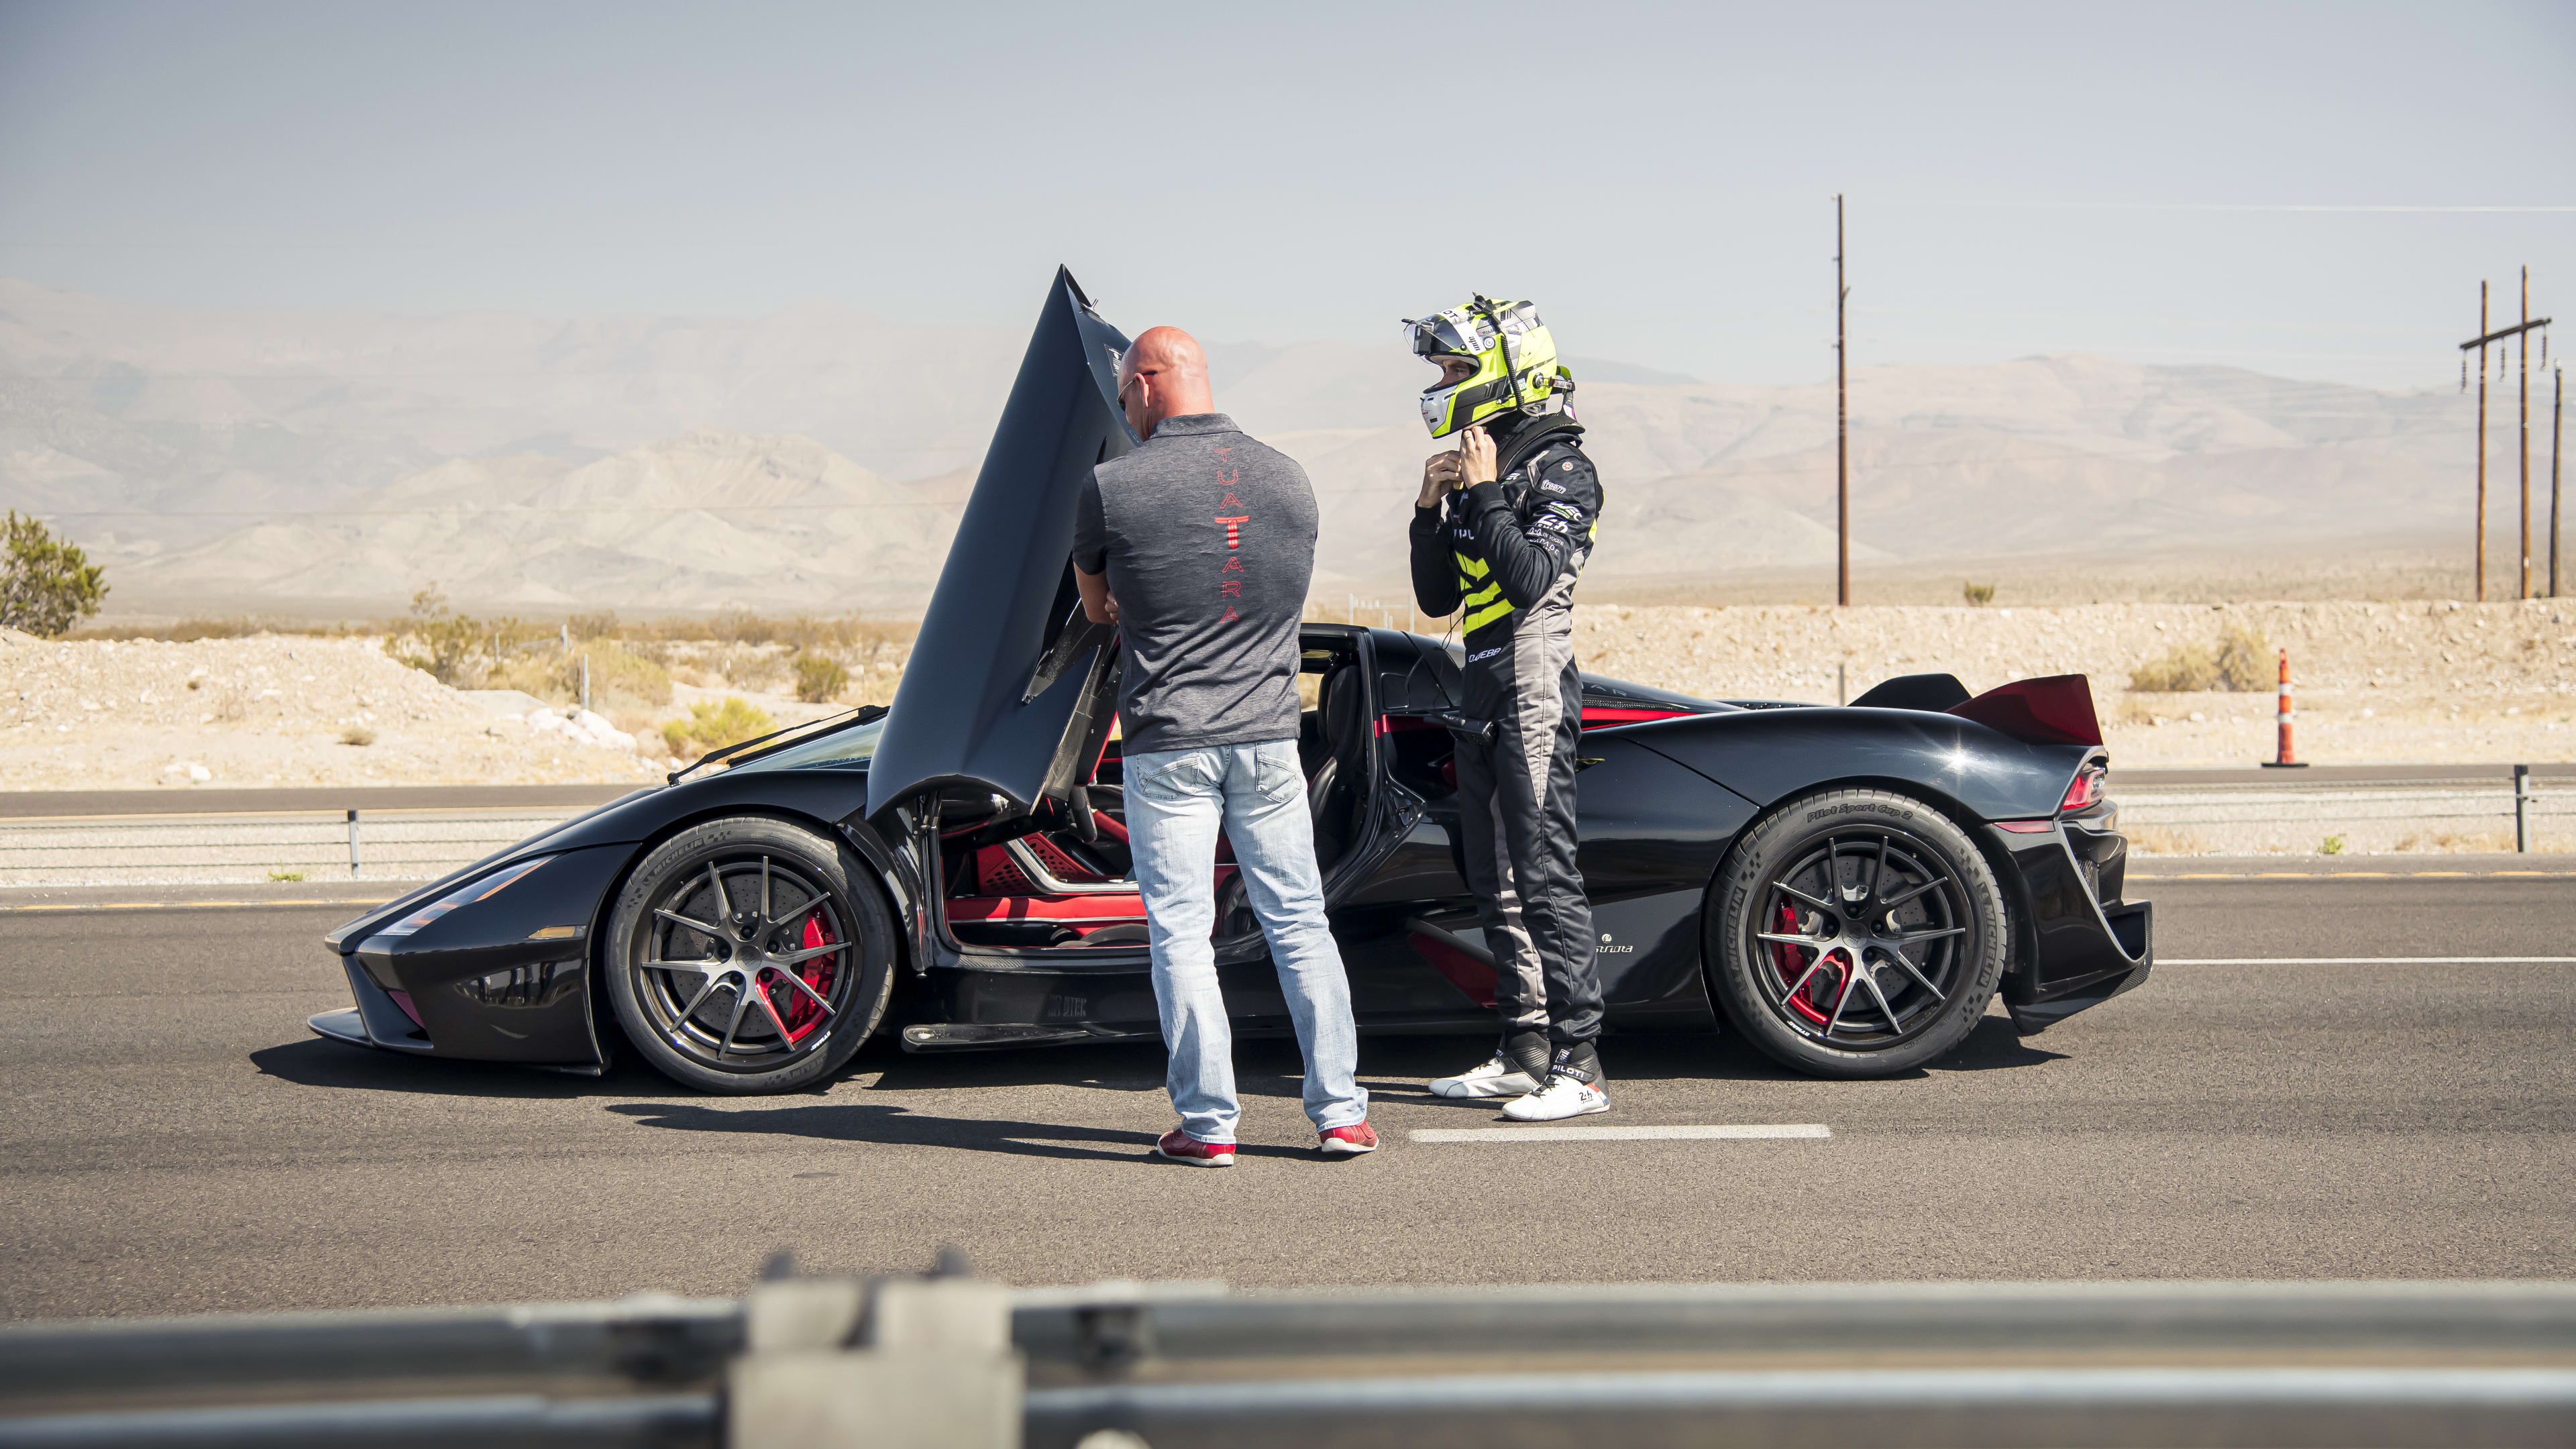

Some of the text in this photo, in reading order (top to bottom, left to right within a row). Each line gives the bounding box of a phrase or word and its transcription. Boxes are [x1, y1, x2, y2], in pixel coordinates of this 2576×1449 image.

[1541, 479, 1567, 494] freem
[1214, 447, 1249, 623] TUATARA
[1839, 803, 1876, 814] Sport
[1878, 804, 1900, 816] Cup
[1901, 811, 1913, 820] 2
[653, 838, 704, 875] MICHELIN
[1727, 887, 1745, 971] MICHELIN
[1980, 904, 1997, 987] MICHELIN
[1552, 1065, 1585, 1079] PILOTI
